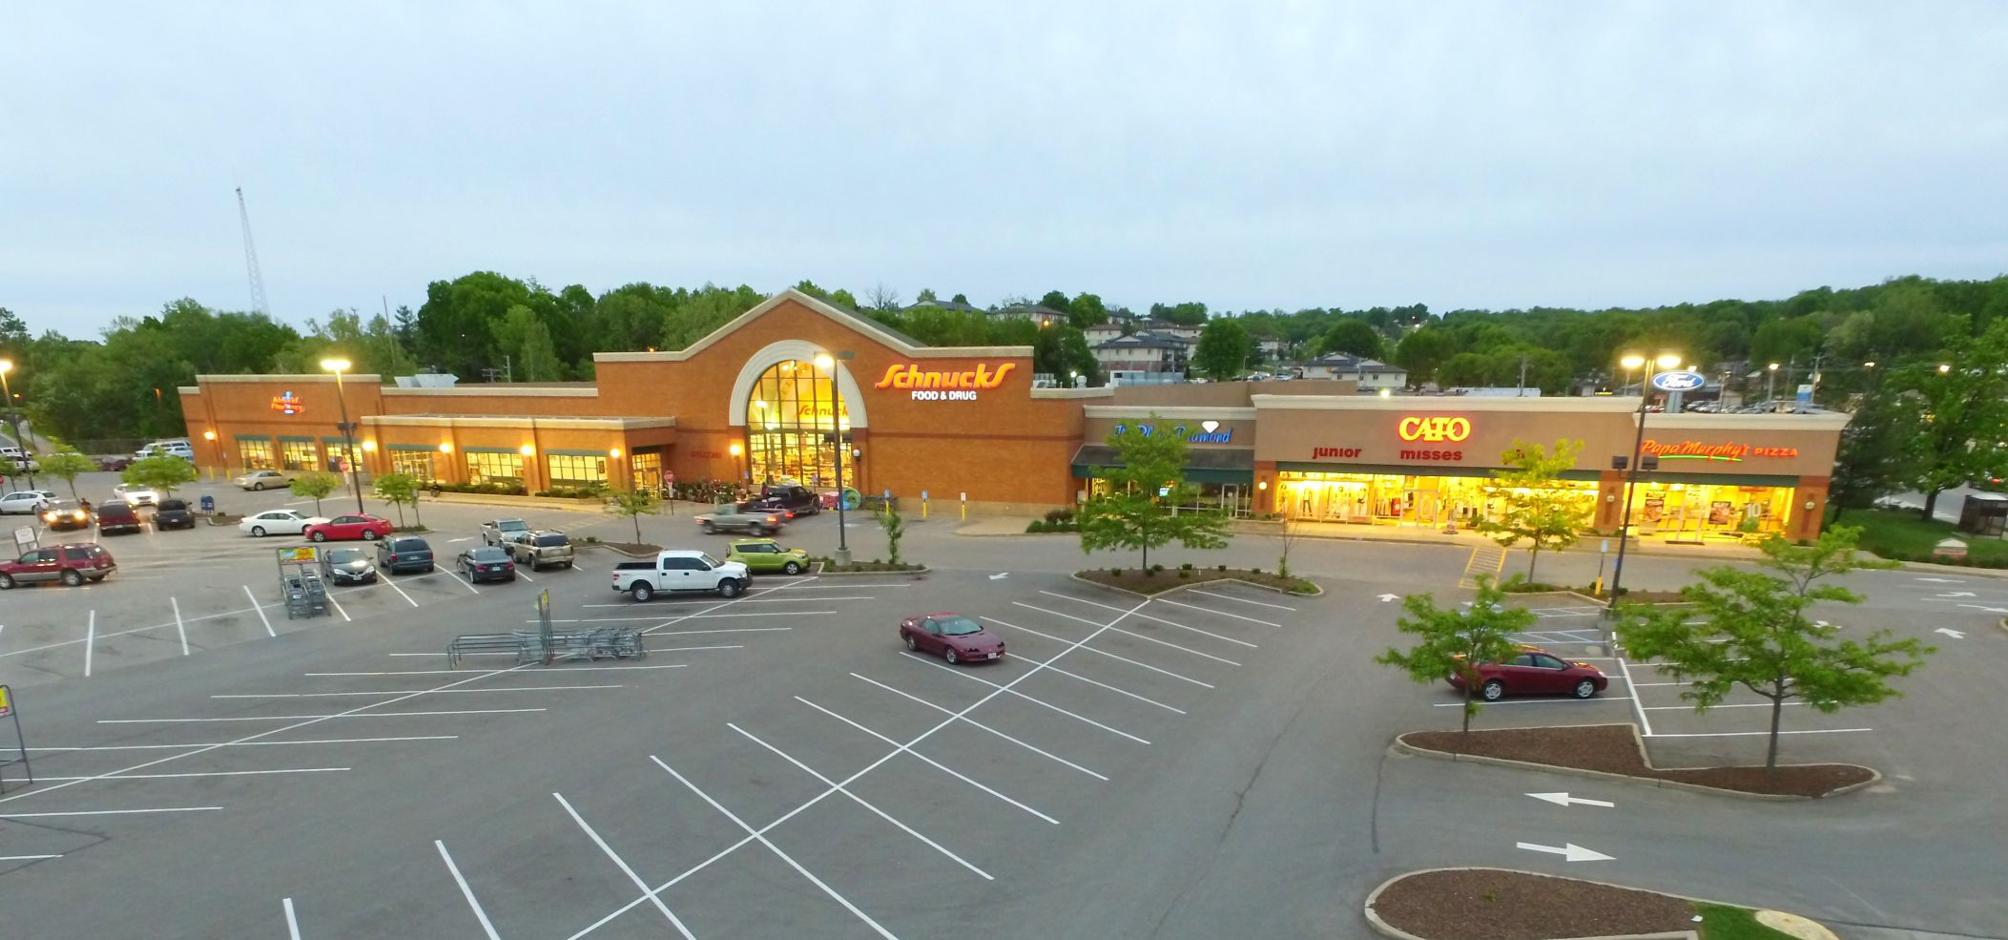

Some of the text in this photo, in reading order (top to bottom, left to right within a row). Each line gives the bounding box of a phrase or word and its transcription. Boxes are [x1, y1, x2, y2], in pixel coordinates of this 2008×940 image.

[875, 362, 1016, 389] Schnucks
[1661, 374, 1696, 389] Ford
[911, 391, 977, 400] FOOD & DRUG
[1398, 416, 1471, 442] CATO
[1312, 446, 1362, 460] junior
[1400, 449, 1463, 461] misses
[1641, 439, 1799, 461] Papa Murphy's PIZZA
